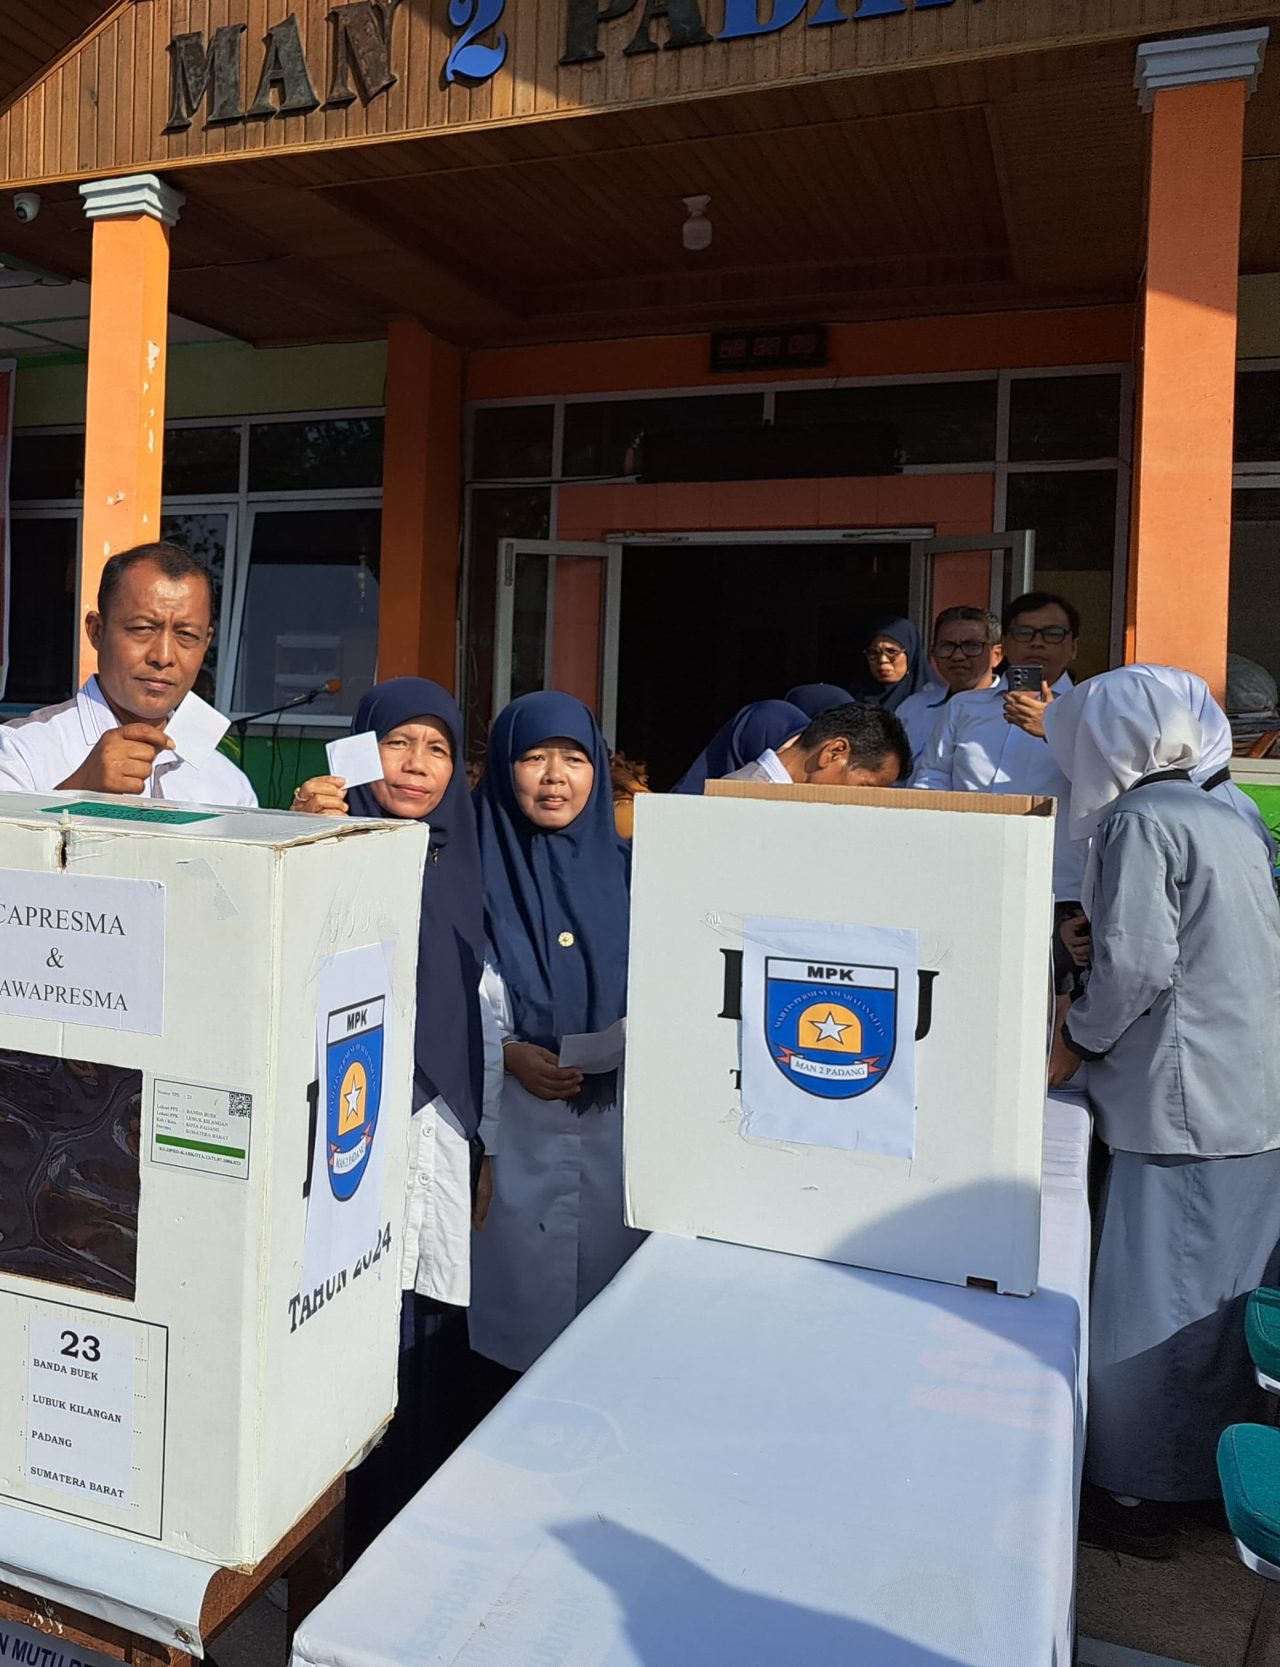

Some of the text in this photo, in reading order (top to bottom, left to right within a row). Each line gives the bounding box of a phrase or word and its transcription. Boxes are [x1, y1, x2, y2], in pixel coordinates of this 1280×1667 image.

[163, 0, 400, 134] MAN
[446, 0, 508, 80] 2
[46, 947, 64, 968] &
[807, 966, 855, 982] MPK
[346, 1008, 368, 1032] MPK
[795, 1061, 866, 1077] MAN 2 PADANG
[288, 1269, 347, 1334] TAHUN
[60, 1330, 102, 1362] 23
[33, 1358, 67, 1374] BANDA
[70, 1367, 99, 1382] BUEK
[32, 1394, 66, 1410] LUBUK
[69, 1403, 122, 1424] KILANGAN
[31, 1430, 72, 1448] PADANG
[30, 1466, 86, 1488] SUMATERA
[89, 1481, 125, 1498] BARAT
[11, 1638, 65, 1667] MUTU
